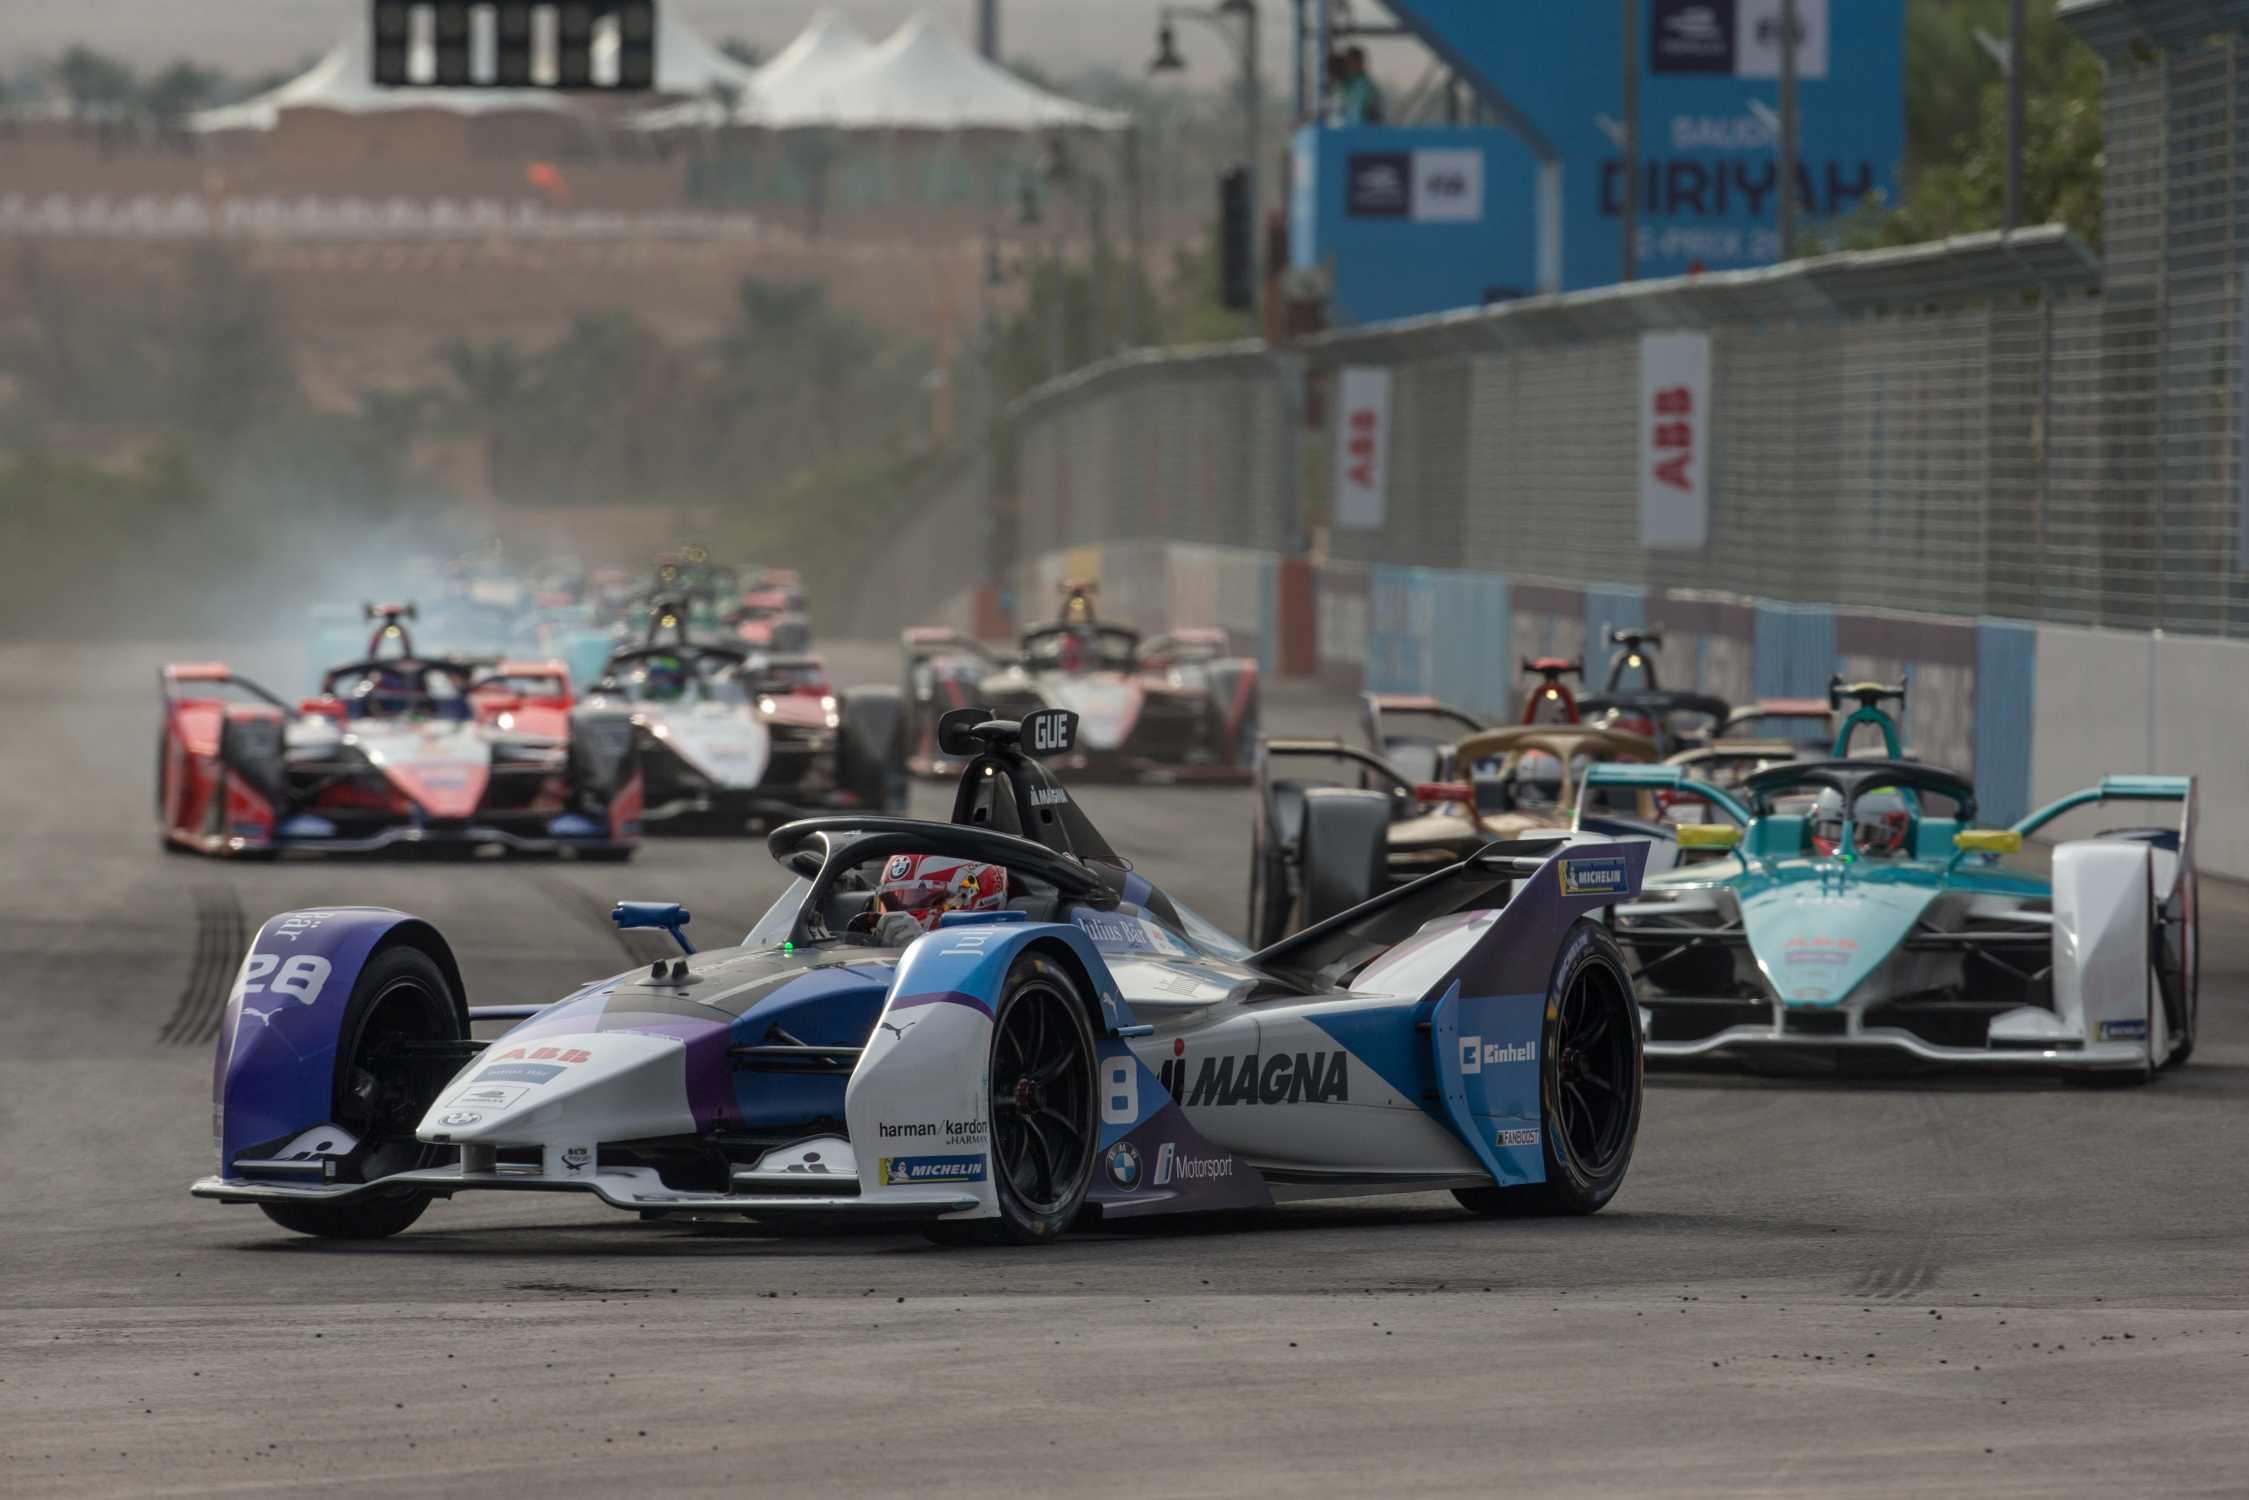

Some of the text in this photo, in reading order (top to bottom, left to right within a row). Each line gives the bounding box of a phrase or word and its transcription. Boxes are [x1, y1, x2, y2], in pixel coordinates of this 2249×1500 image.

[1348, 409, 1377, 488] ABB
[1652, 385, 1693, 493] ABB
[1035, 714, 1068, 749] GUE
[1579, 869, 1621, 884] MICHELIN
[1077, 918, 1120, 941] Julius
[227, 953, 333, 1005] 28
[489, 1047, 592, 1064] ABB
[1483, 1041, 1536, 1064] Einhell
[1186, 1051, 1349, 1107] MAGNA
[911, 1163, 983, 1177] MICHELIN
[1176, 1155, 1233, 1182] Motorsport
